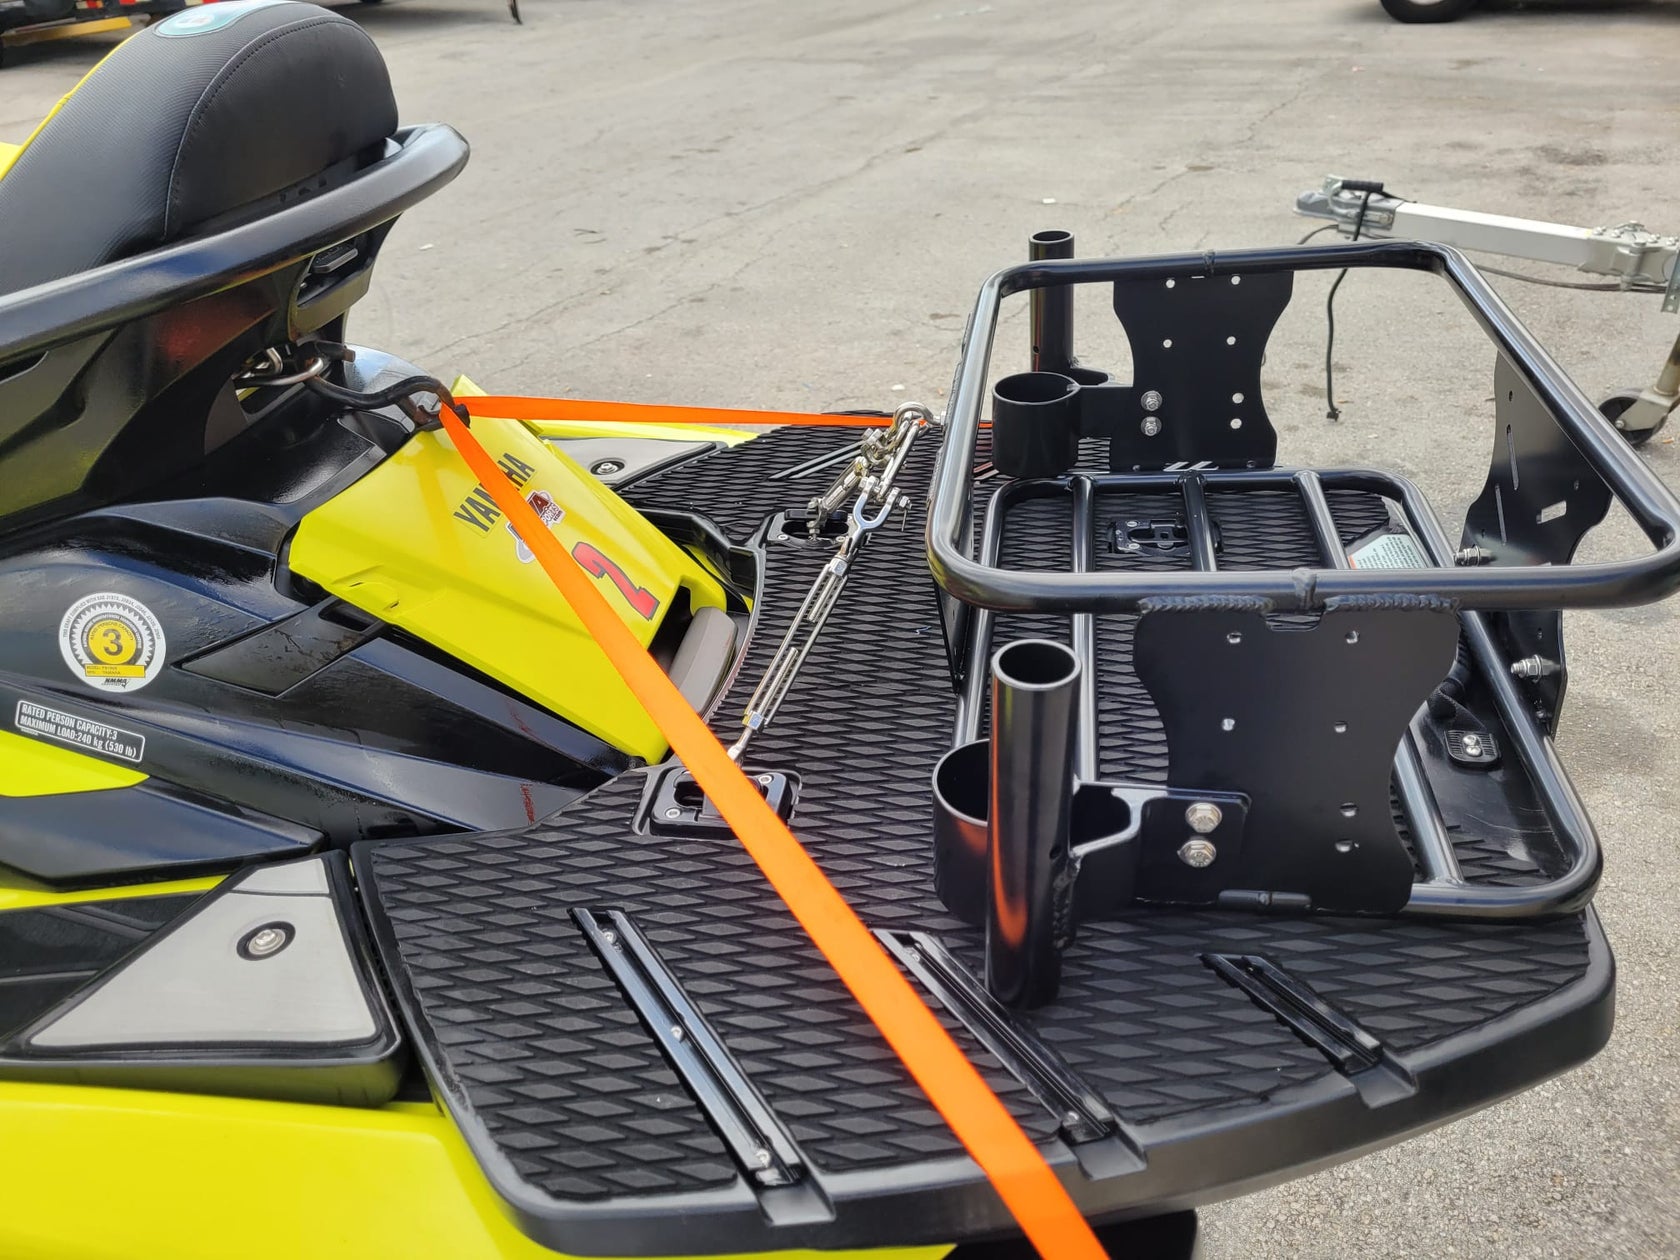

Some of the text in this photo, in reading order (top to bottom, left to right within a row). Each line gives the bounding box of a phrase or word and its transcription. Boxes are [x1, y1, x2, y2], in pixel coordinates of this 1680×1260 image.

[571, 541, 660, 621] 2
[102, 628, 123, 656] 3
[21, 704, 46, 718] RATED
[46, 711, 76, 728] PERSON
[20, 715, 56, 734] MAXIMUM
[93, 737, 103, 749] kg
[105, 740, 124, 754] (530
[125, 746, 137, 758] lb)
